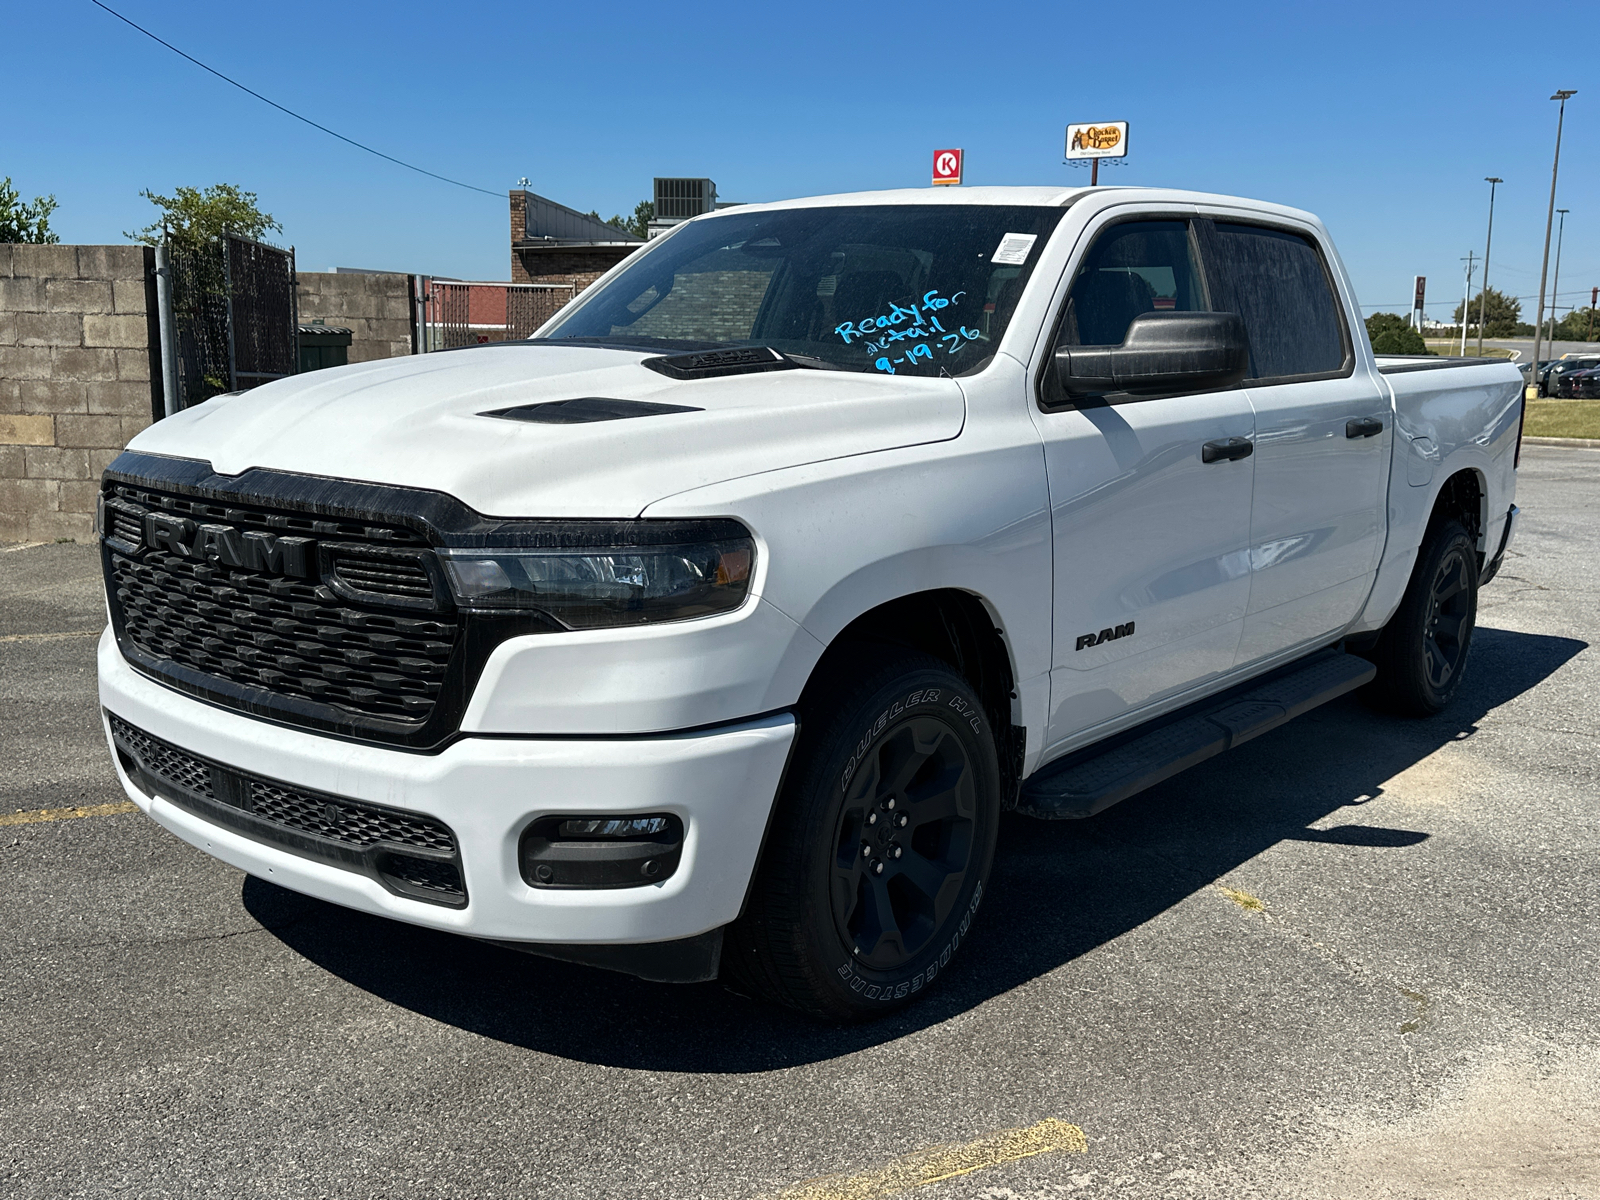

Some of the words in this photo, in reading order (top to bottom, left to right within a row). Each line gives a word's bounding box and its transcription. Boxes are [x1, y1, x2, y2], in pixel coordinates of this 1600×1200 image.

[942, 157, 954, 172] K
[835, 301, 927, 344] Ready
[922, 290, 966, 311] for
[145, 511, 316, 578] RAM
[1076, 621, 1135, 652] RAM
[841, 688, 941, 793] DUELER
[836, 879, 984, 1001] BRIDGESTONE
